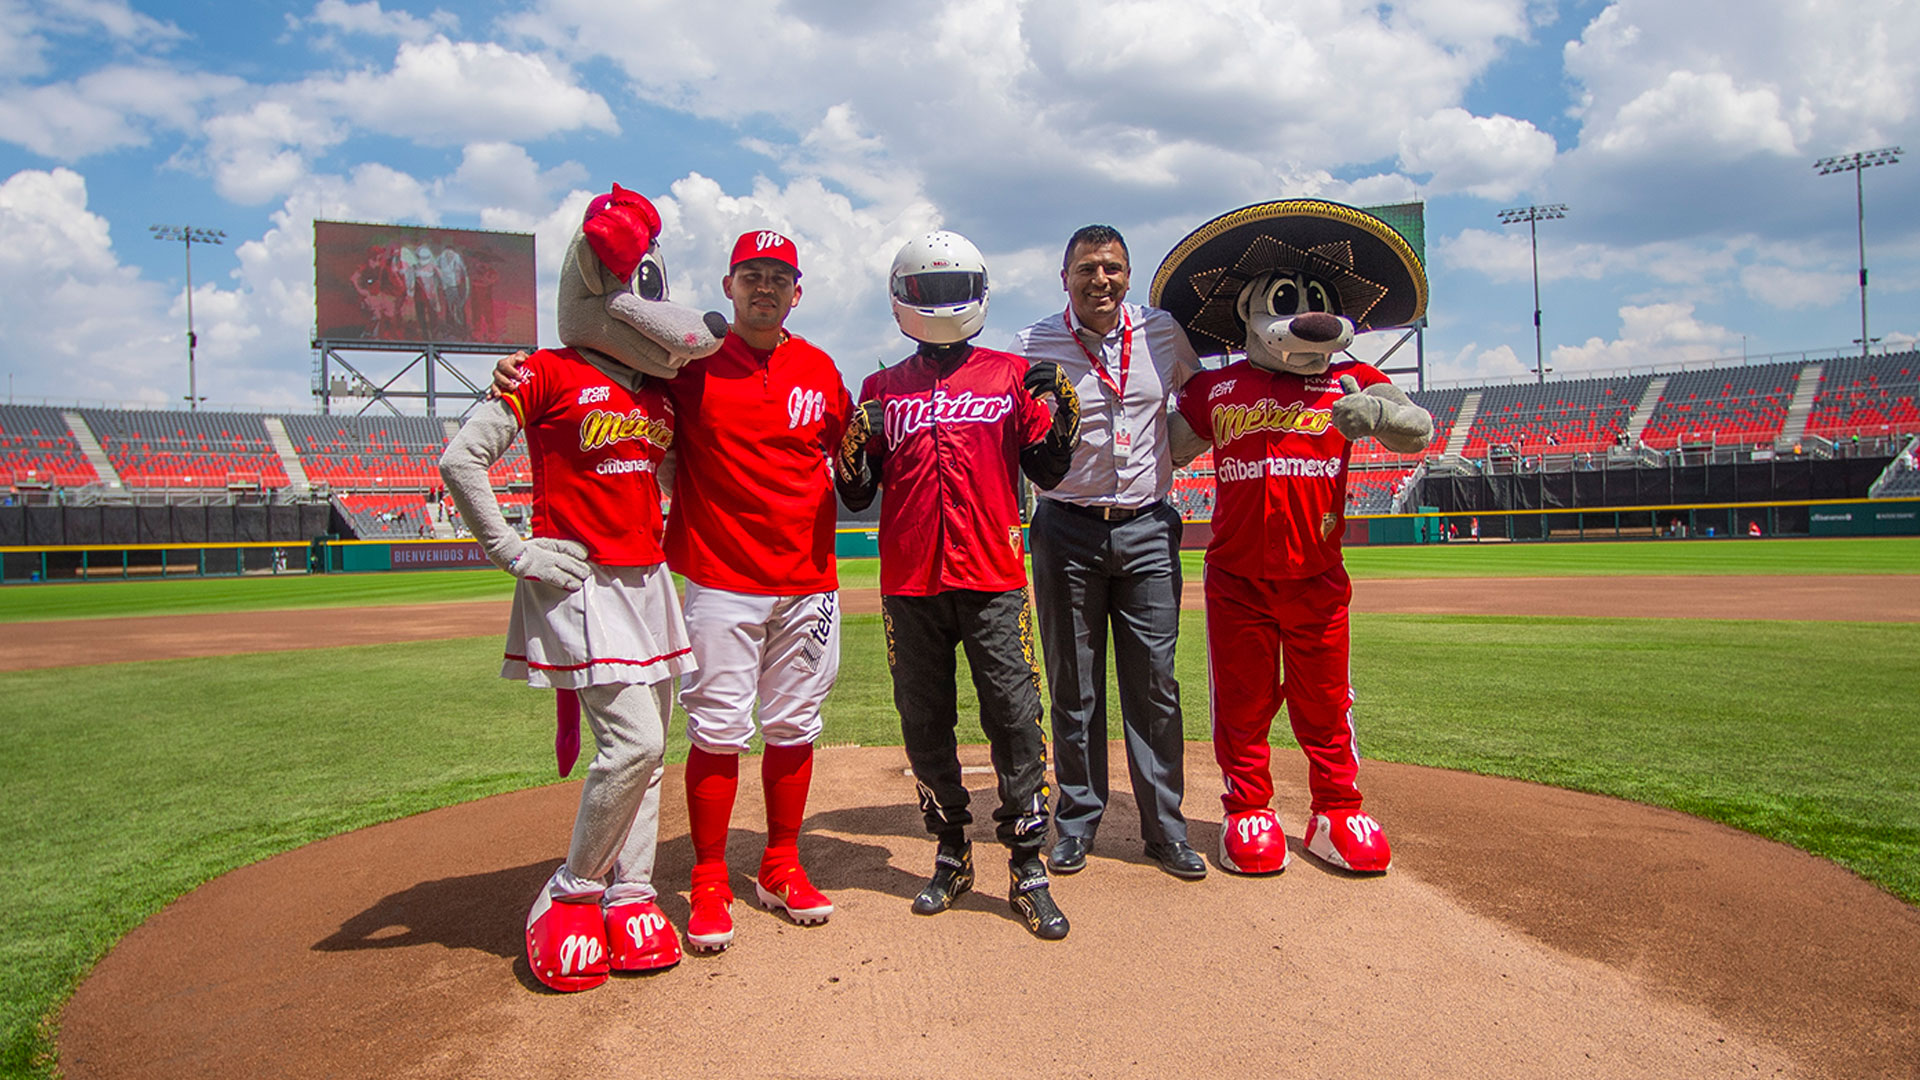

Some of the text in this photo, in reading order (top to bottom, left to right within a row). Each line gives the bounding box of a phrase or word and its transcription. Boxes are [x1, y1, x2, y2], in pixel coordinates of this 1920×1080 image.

[884, 391, 1013, 451] México
[1218, 457, 1327, 483] citibanamex
[394, 549, 464, 563] BIENVENIDOS
[467, 549, 481, 561] AL
